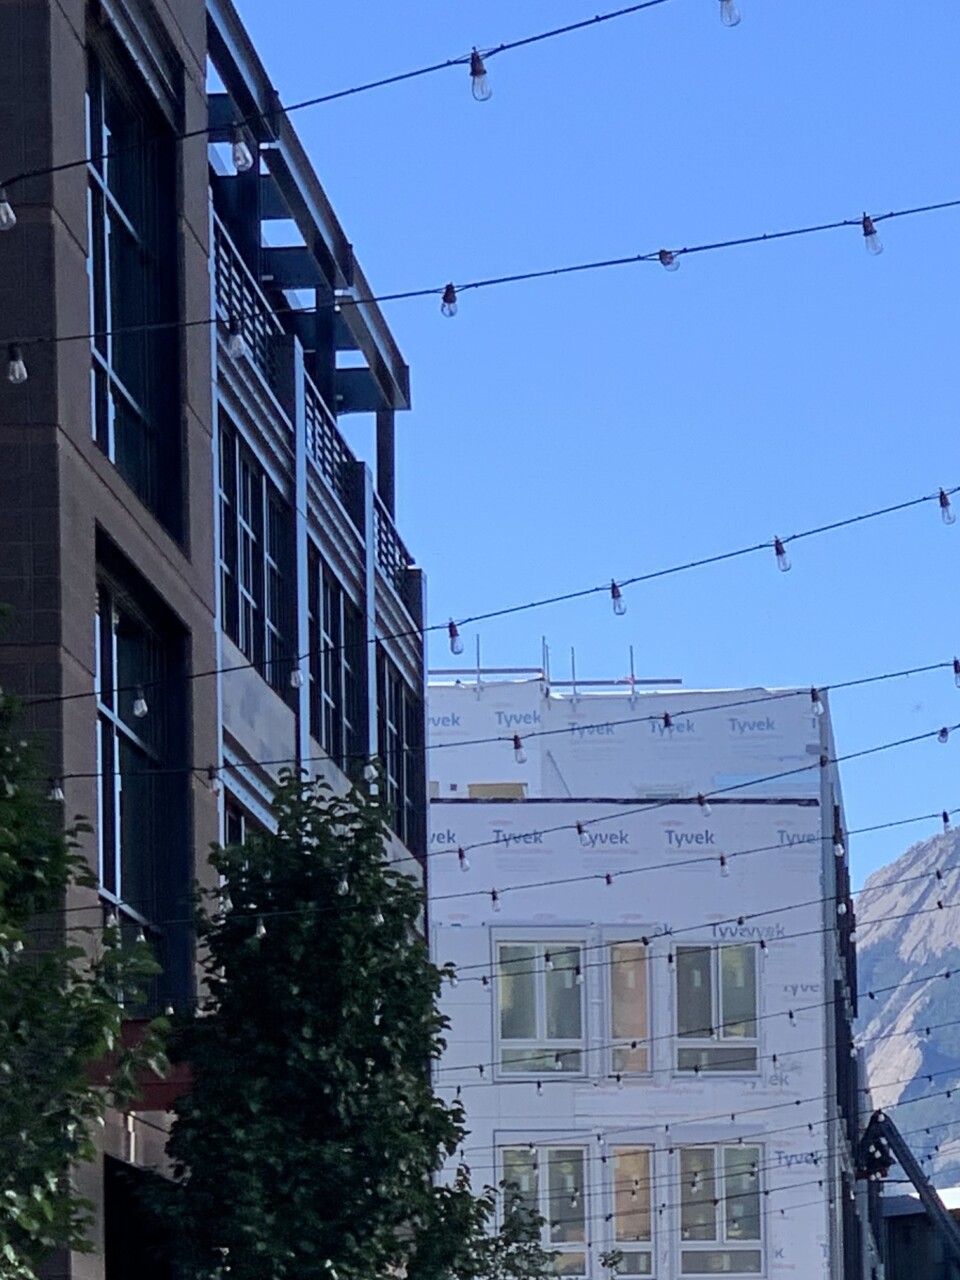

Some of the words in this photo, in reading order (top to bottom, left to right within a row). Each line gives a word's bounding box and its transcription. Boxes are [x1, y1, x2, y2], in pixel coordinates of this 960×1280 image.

[495, 710, 541, 727] Tyvek
[729, 717, 775, 734] Tyvek
[567, 722, 615, 738] Tyvek
[493, 829, 543, 847] Tyvek
[665, 829, 714, 848] Tyvek
